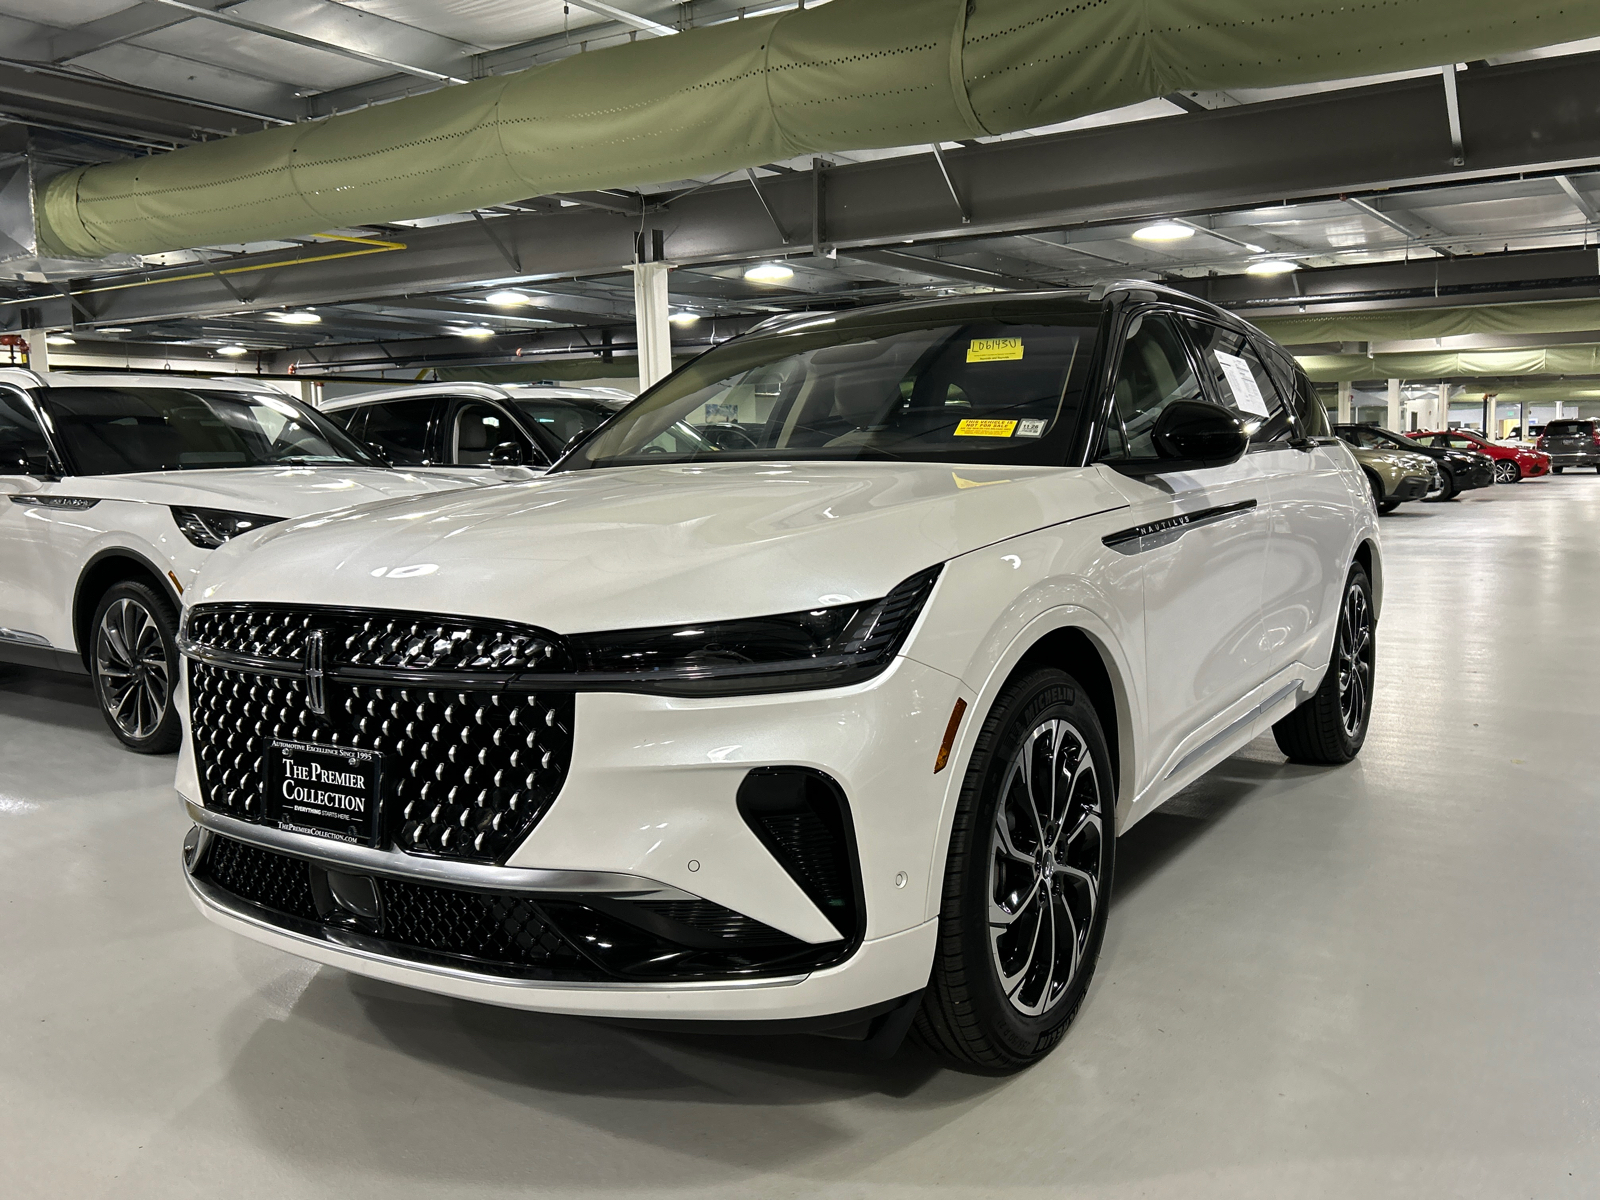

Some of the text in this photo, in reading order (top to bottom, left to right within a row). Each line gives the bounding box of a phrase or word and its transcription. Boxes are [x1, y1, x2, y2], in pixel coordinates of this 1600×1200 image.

[1141, 515, 1190, 535] NAUTILUS
[1024, 687, 1075, 725] MICHELIN
[357, 751, 372, 760] 1995
[282, 758, 366, 789] THE PREMIER
[282, 779, 366, 812] COLLECTION
[294, 805, 350, 821] EVERYTHING STARTS HERE
